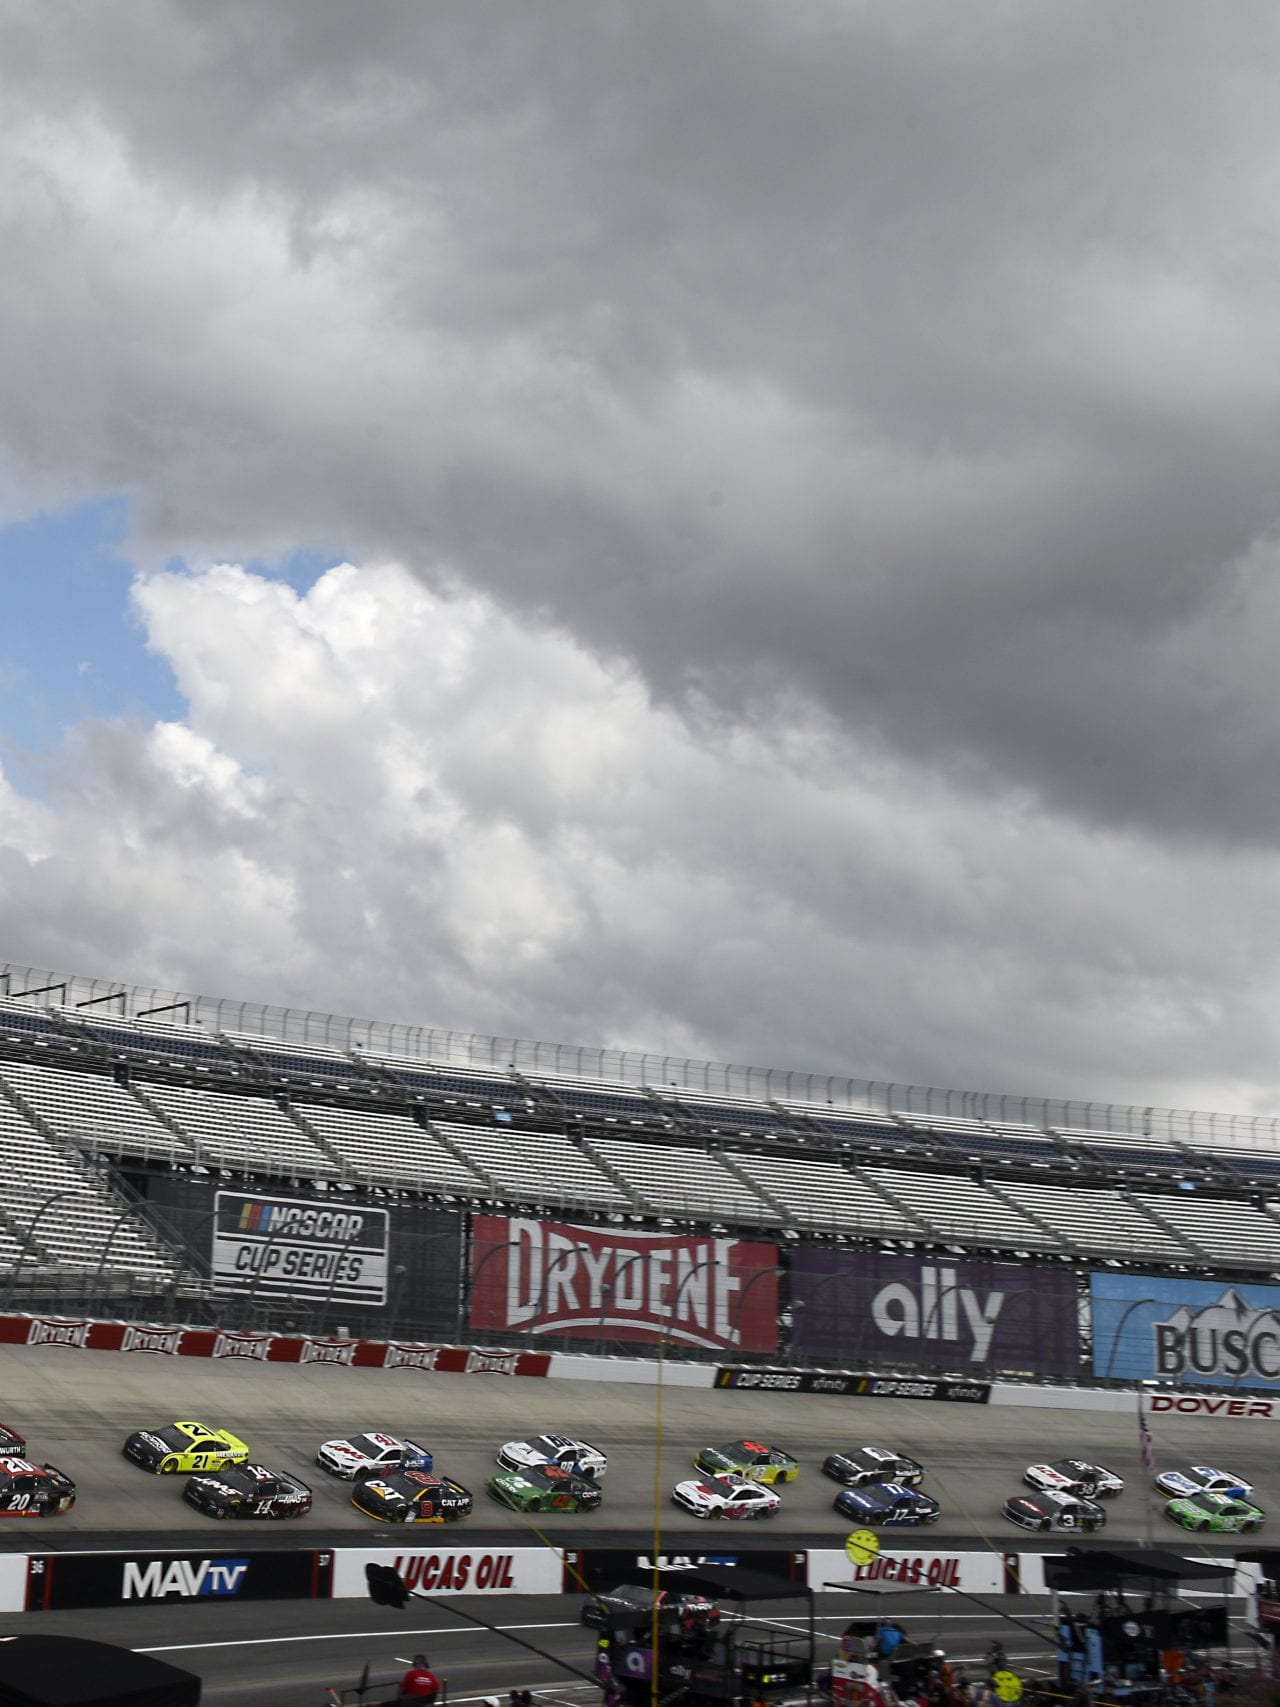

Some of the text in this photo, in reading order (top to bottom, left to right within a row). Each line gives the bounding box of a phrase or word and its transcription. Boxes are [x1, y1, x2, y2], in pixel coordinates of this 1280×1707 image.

[268, 1206, 363, 1241] NASCAR
[235, 1245, 363, 1281] CUP SERIES
[506, 1217, 742, 1345] DRYDENE
[872, 1266, 1004, 1362] ally
[1151, 1396, 1273, 1418] DOVER
[192, 1454, 209, 1469] 21
[247, 1465, 274, 1480] 14
[364, 1480, 406, 1500] CAT
[1078, 1483, 1095, 1495] 38
[7, 1493, 30, 1510] 20
[253, 1499, 273, 1514] 14
[421, 1501, 433, 1517] 8
[441, 1499, 456, 1507] CAT
[1062, 1514, 1074, 1527] 3
[30, 1560, 45, 1574] 36
[475, 1555, 514, 1589] OIL
[854, 1558, 961, 1587] LUCAS OIL
[122, 1559, 249, 1599] MAVTV
